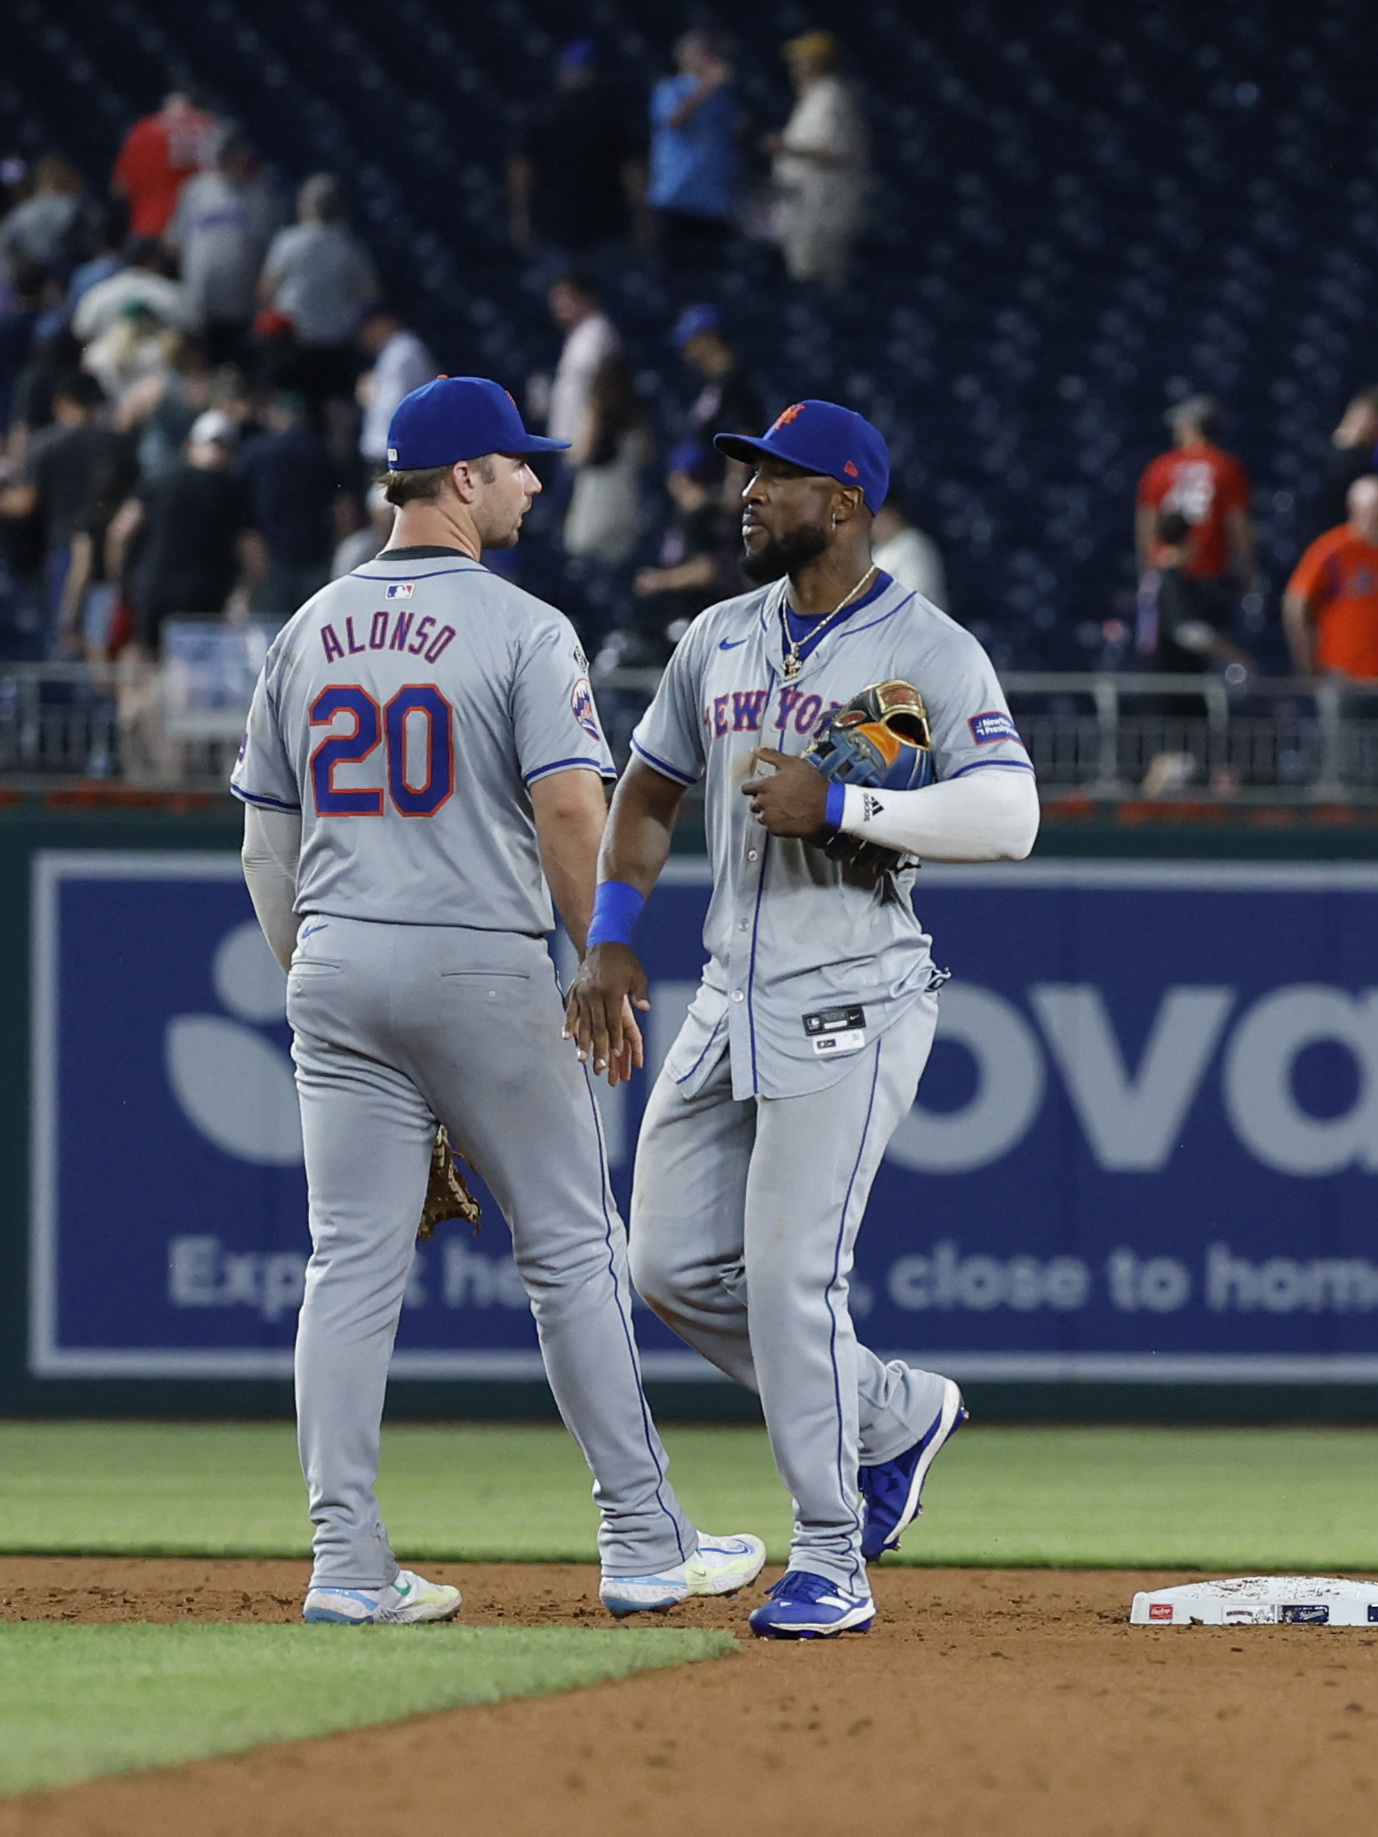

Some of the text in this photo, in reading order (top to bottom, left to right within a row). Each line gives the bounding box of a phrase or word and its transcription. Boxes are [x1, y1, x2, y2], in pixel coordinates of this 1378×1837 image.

[320, 611, 457, 664] ALONSO
[775, 687, 845, 740] YO
[309, 683, 455, 818] 20
[863, 792, 872, 822] adidas
[889, 1239, 1089, 1311] close
[1108, 1246, 1191, 1312] to
